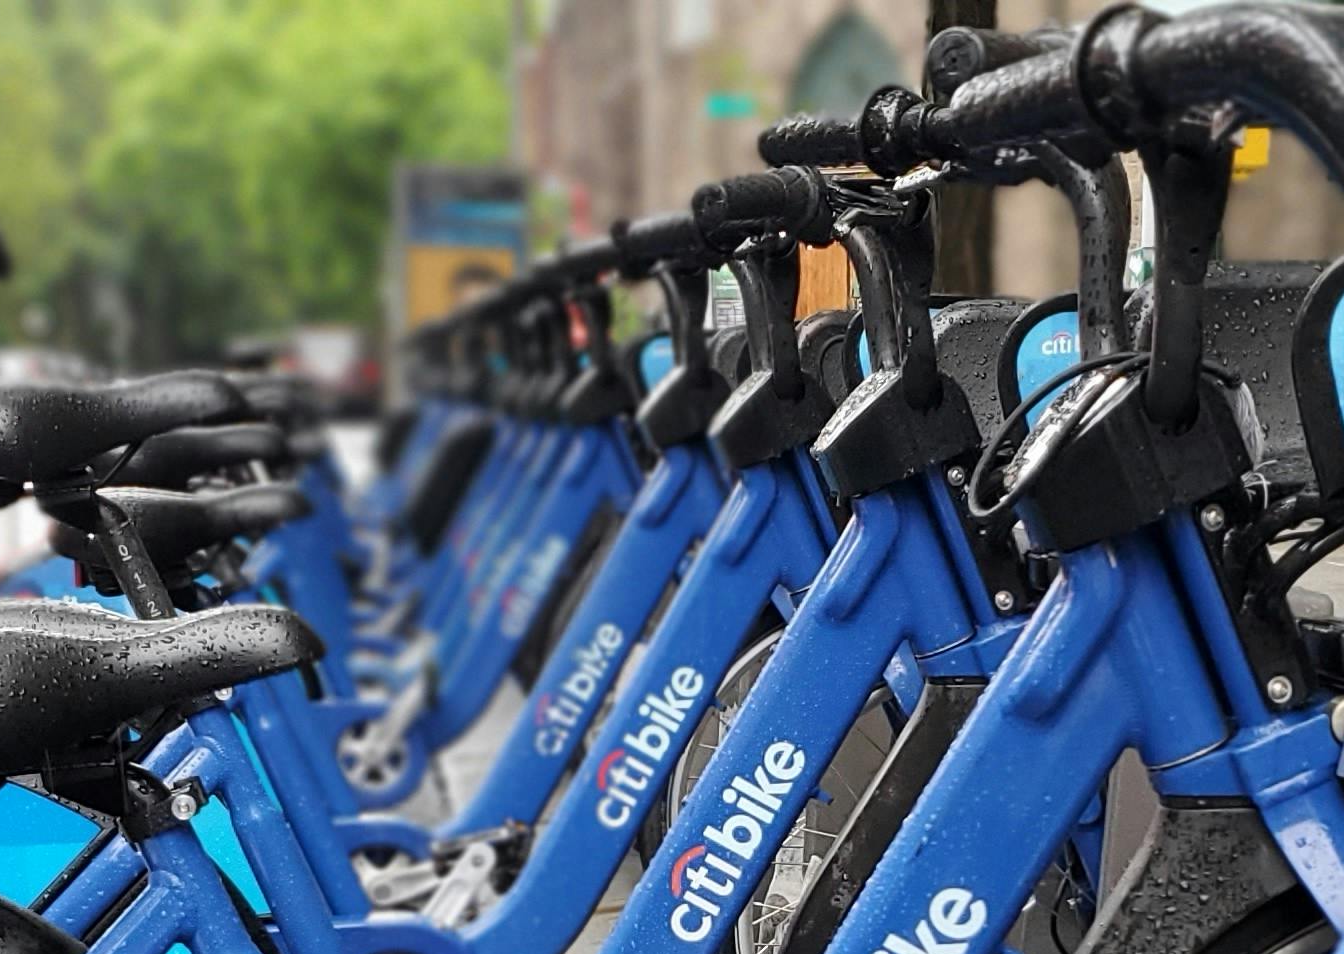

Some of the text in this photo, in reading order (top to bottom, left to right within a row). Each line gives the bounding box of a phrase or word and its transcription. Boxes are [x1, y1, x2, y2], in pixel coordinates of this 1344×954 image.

[1040, 332, 1072, 355] citi
[535, 623, 624, 757] citi bike
[596, 666, 704, 829] citi bike
[670, 741, 806, 942] citi bike
